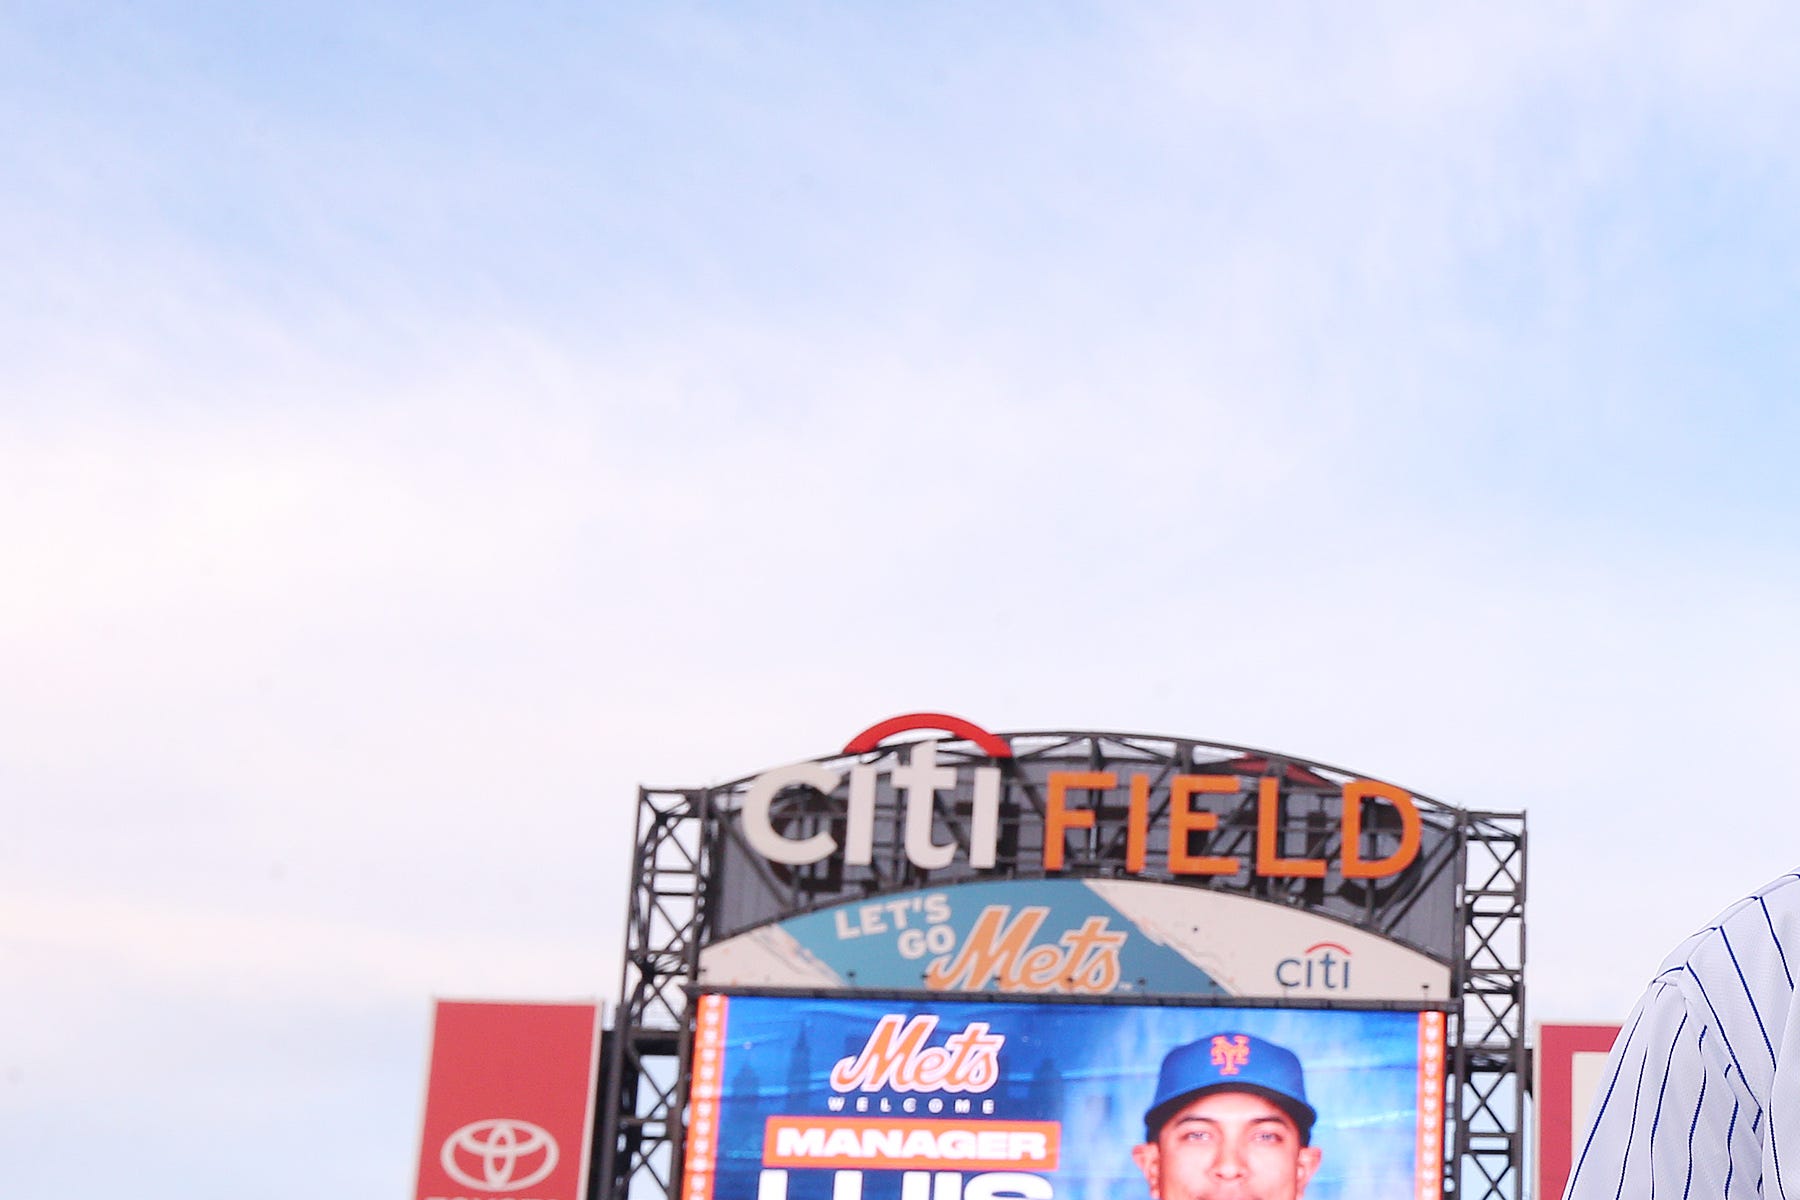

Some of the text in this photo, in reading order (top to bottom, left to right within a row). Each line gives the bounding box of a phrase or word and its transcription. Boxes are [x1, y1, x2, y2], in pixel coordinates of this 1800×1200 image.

[741, 741, 1421, 878] citi FIELD
[834, 893, 952, 940] LET'S
[898, 924, 956, 960] GO
[924, 904, 1129, 994] Mets
[1276, 951, 1350, 989] citi
[829, 1013, 1006, 1094] Mets
[827, 1096, 996, 1116] WELCOME
[775, 1127, 1048, 1160] MANAGER
